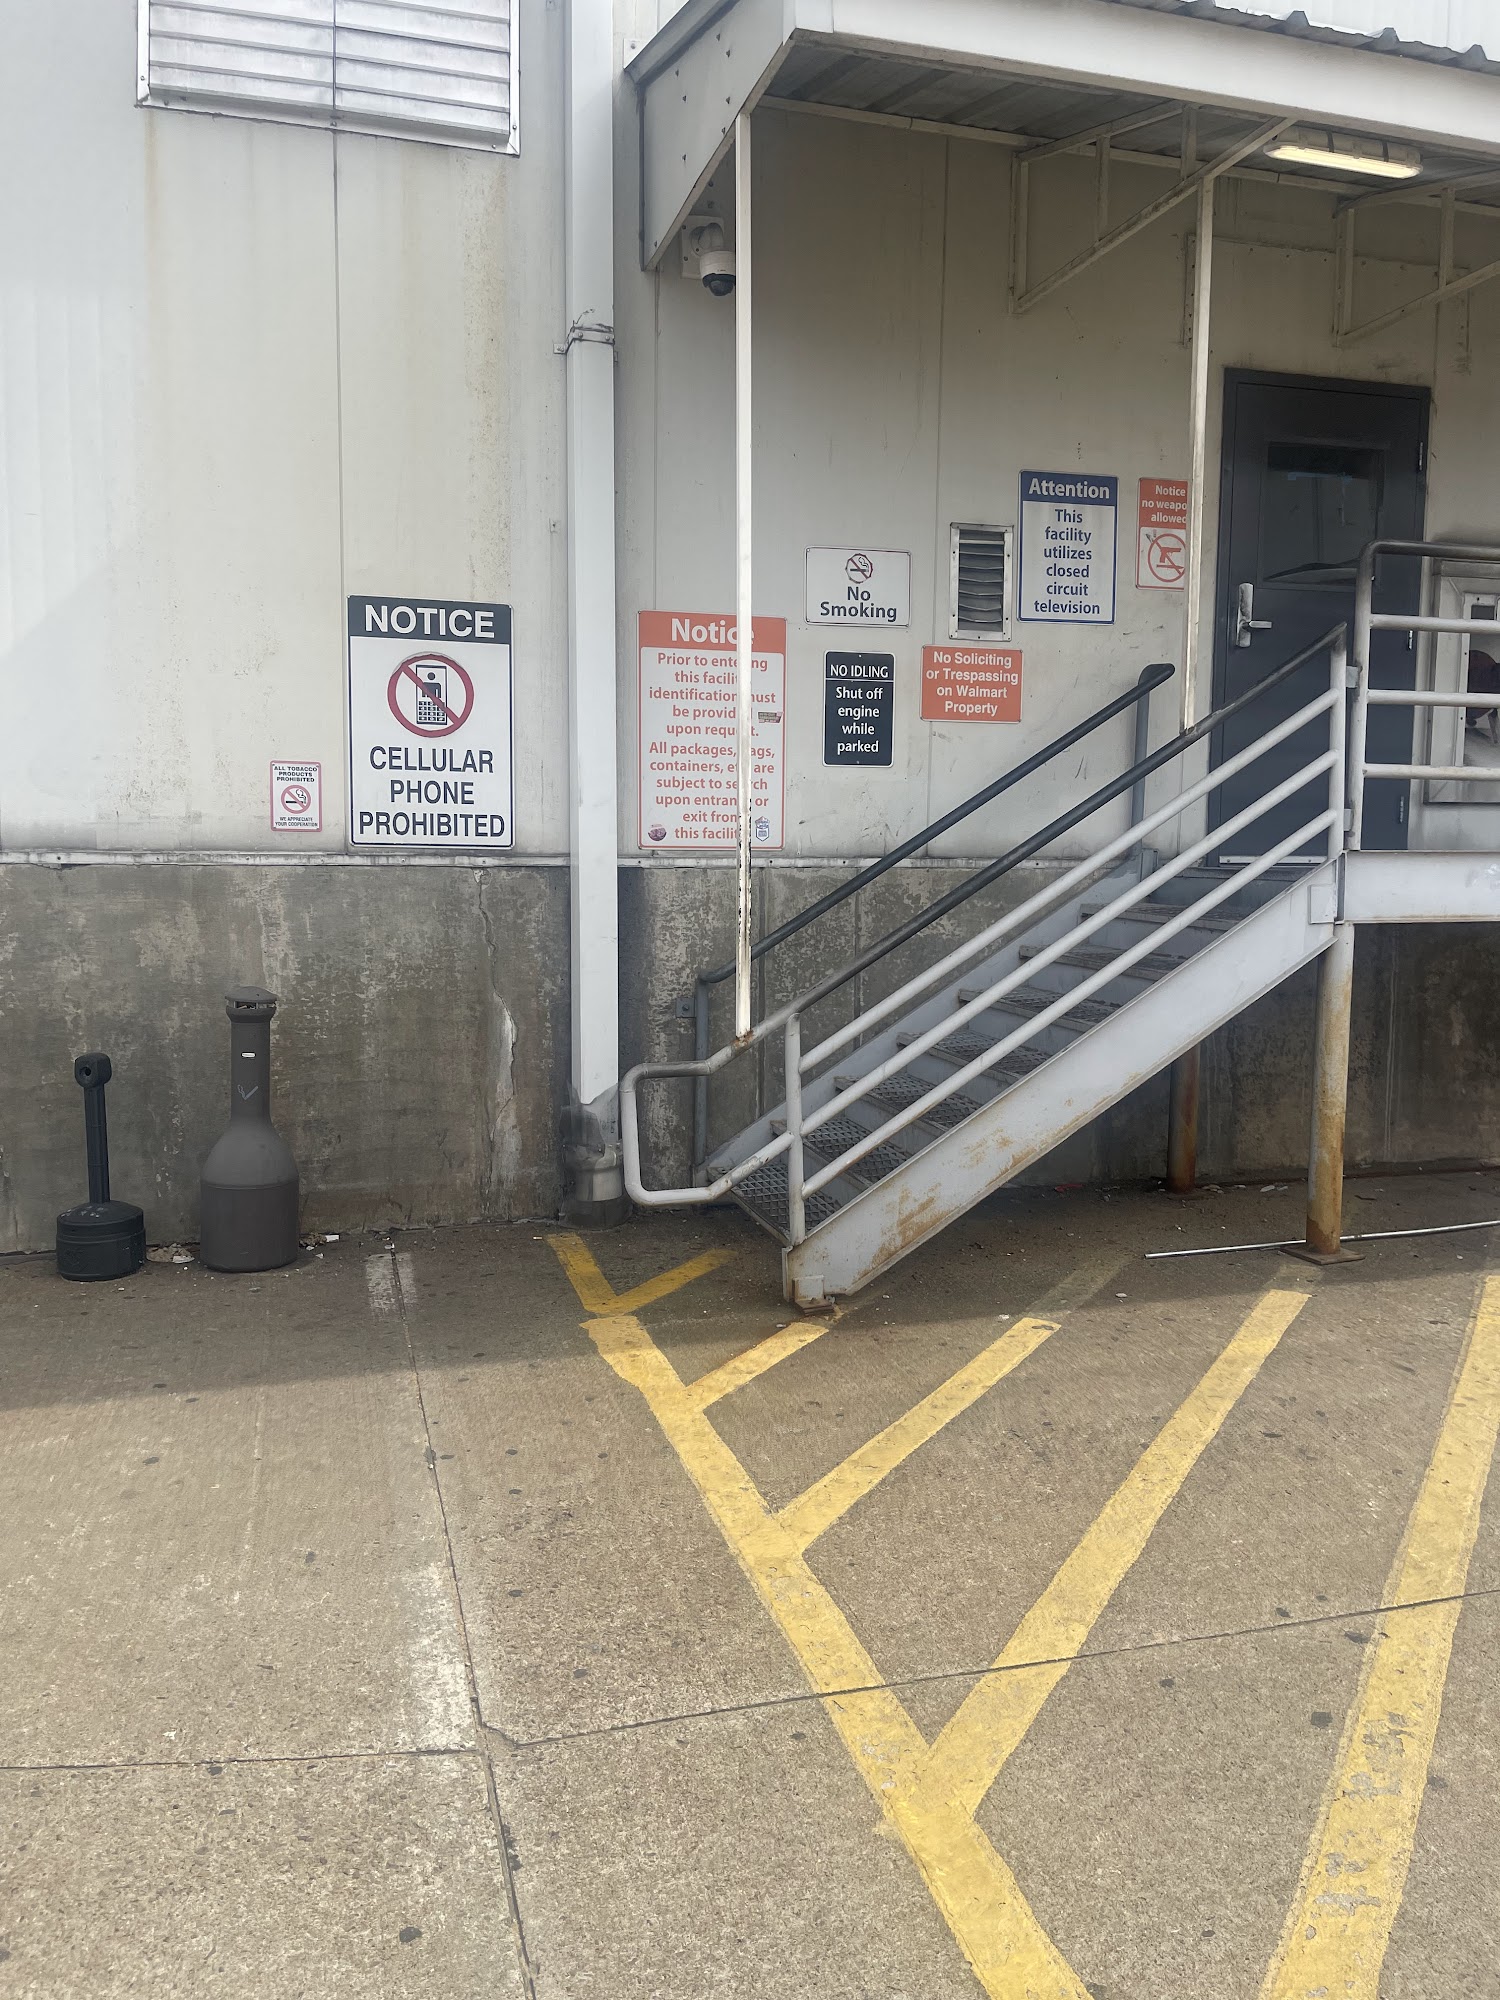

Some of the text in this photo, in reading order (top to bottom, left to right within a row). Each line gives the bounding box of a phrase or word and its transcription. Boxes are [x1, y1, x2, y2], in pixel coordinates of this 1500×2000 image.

[1029, 478, 1110, 499] Attention
[1155, 485, 1186, 497] Notice
[1141, 500, 1187, 512] no weapo
[1055, 508, 1083, 523] This
[1045, 526, 1092, 545] facility
[1044, 545, 1092, 560] utilizes
[1046, 564, 1090, 578] closed
[847, 586, 871, 601] No
[1046, 582, 1089, 596] circuit
[820, 601, 897, 623] Smoking
[1034, 600, 1100, 614] television
[365, 604, 495, 638] NOTICE
[671, 618, 755, 645] Notic
[657, 652, 768, 672] Prior to enteng
[933, 651, 1012, 668] No Soliciting
[674, 670, 737, 685] this facili
[830, 664, 889, 678] NO IDLING
[926, 668, 1019, 685] or Trespassing
[835, 686, 883, 700] Shut off
[936, 685, 1008, 699] on Walmart
[672, 705, 689, 717] be
[693, 706, 752, 720] provid
[837, 705, 880, 720] engine
[944, 700, 998, 717] Property
[666, 724, 759, 739] upon requt.
[841, 722, 875, 735] while
[649, 741, 775, 759] All packages, ags,
[837, 740, 879, 755] parked
[370, 746, 494, 774] CELLULAR
[649, 760, 724, 774] containers,
[753, 764, 775, 774] are
[656, 776, 768, 792] subject to sech
[390, 780, 475, 805] PHONE
[655, 795, 769, 808] upon entran or
[682, 811, 708, 822] exit
[359, 811, 505, 838] PROHIBITED
[674, 827, 699, 839] this
